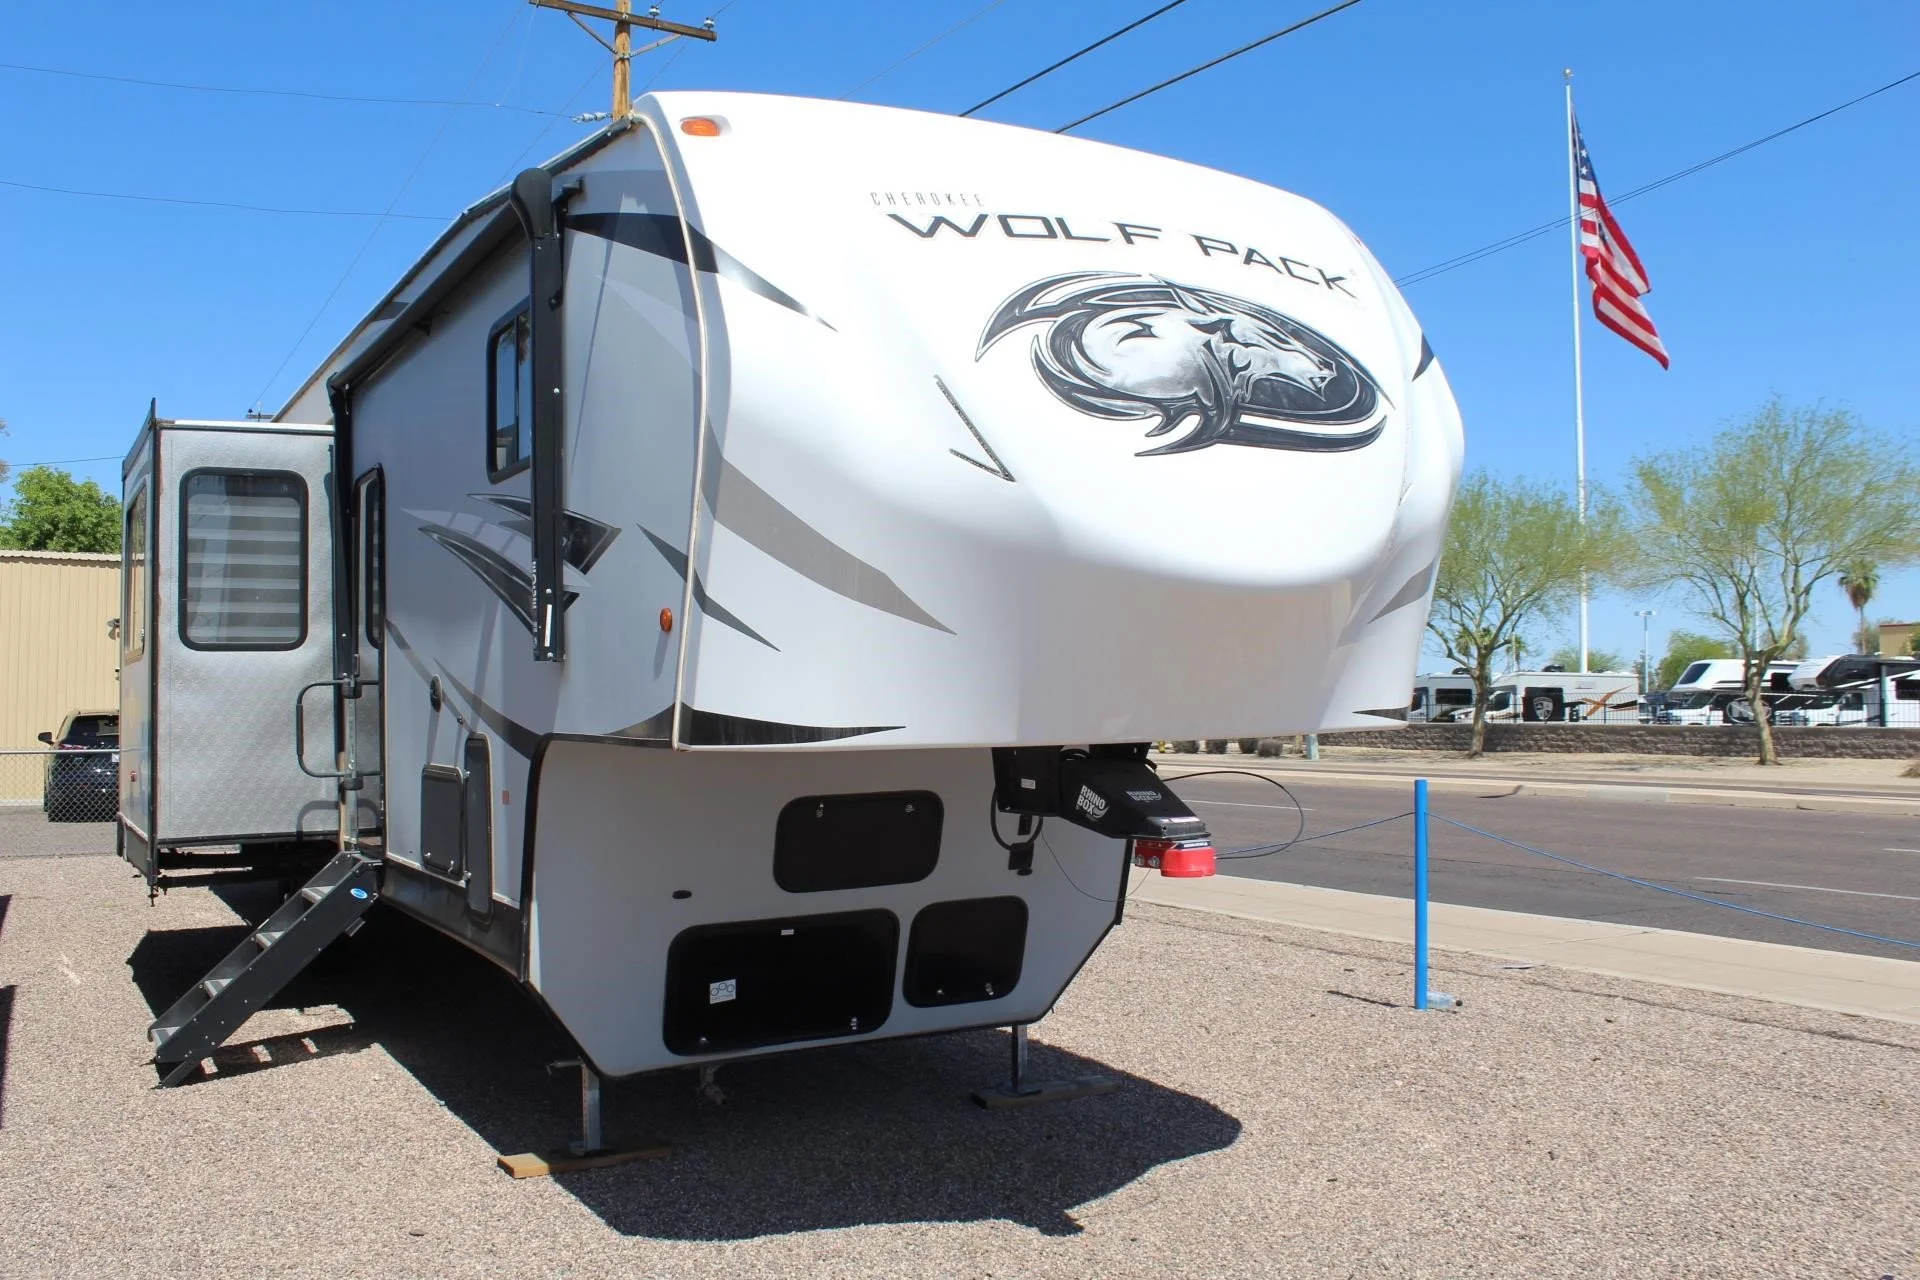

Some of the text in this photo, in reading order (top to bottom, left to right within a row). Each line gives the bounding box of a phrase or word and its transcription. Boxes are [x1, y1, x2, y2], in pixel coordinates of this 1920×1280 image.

[870, 192, 984, 207] CHEROKEE
[886, 213, 1359, 300] WOLF PACK
[1077, 795, 1095, 815] BOX
[1080, 784, 1106, 810] RHINO
